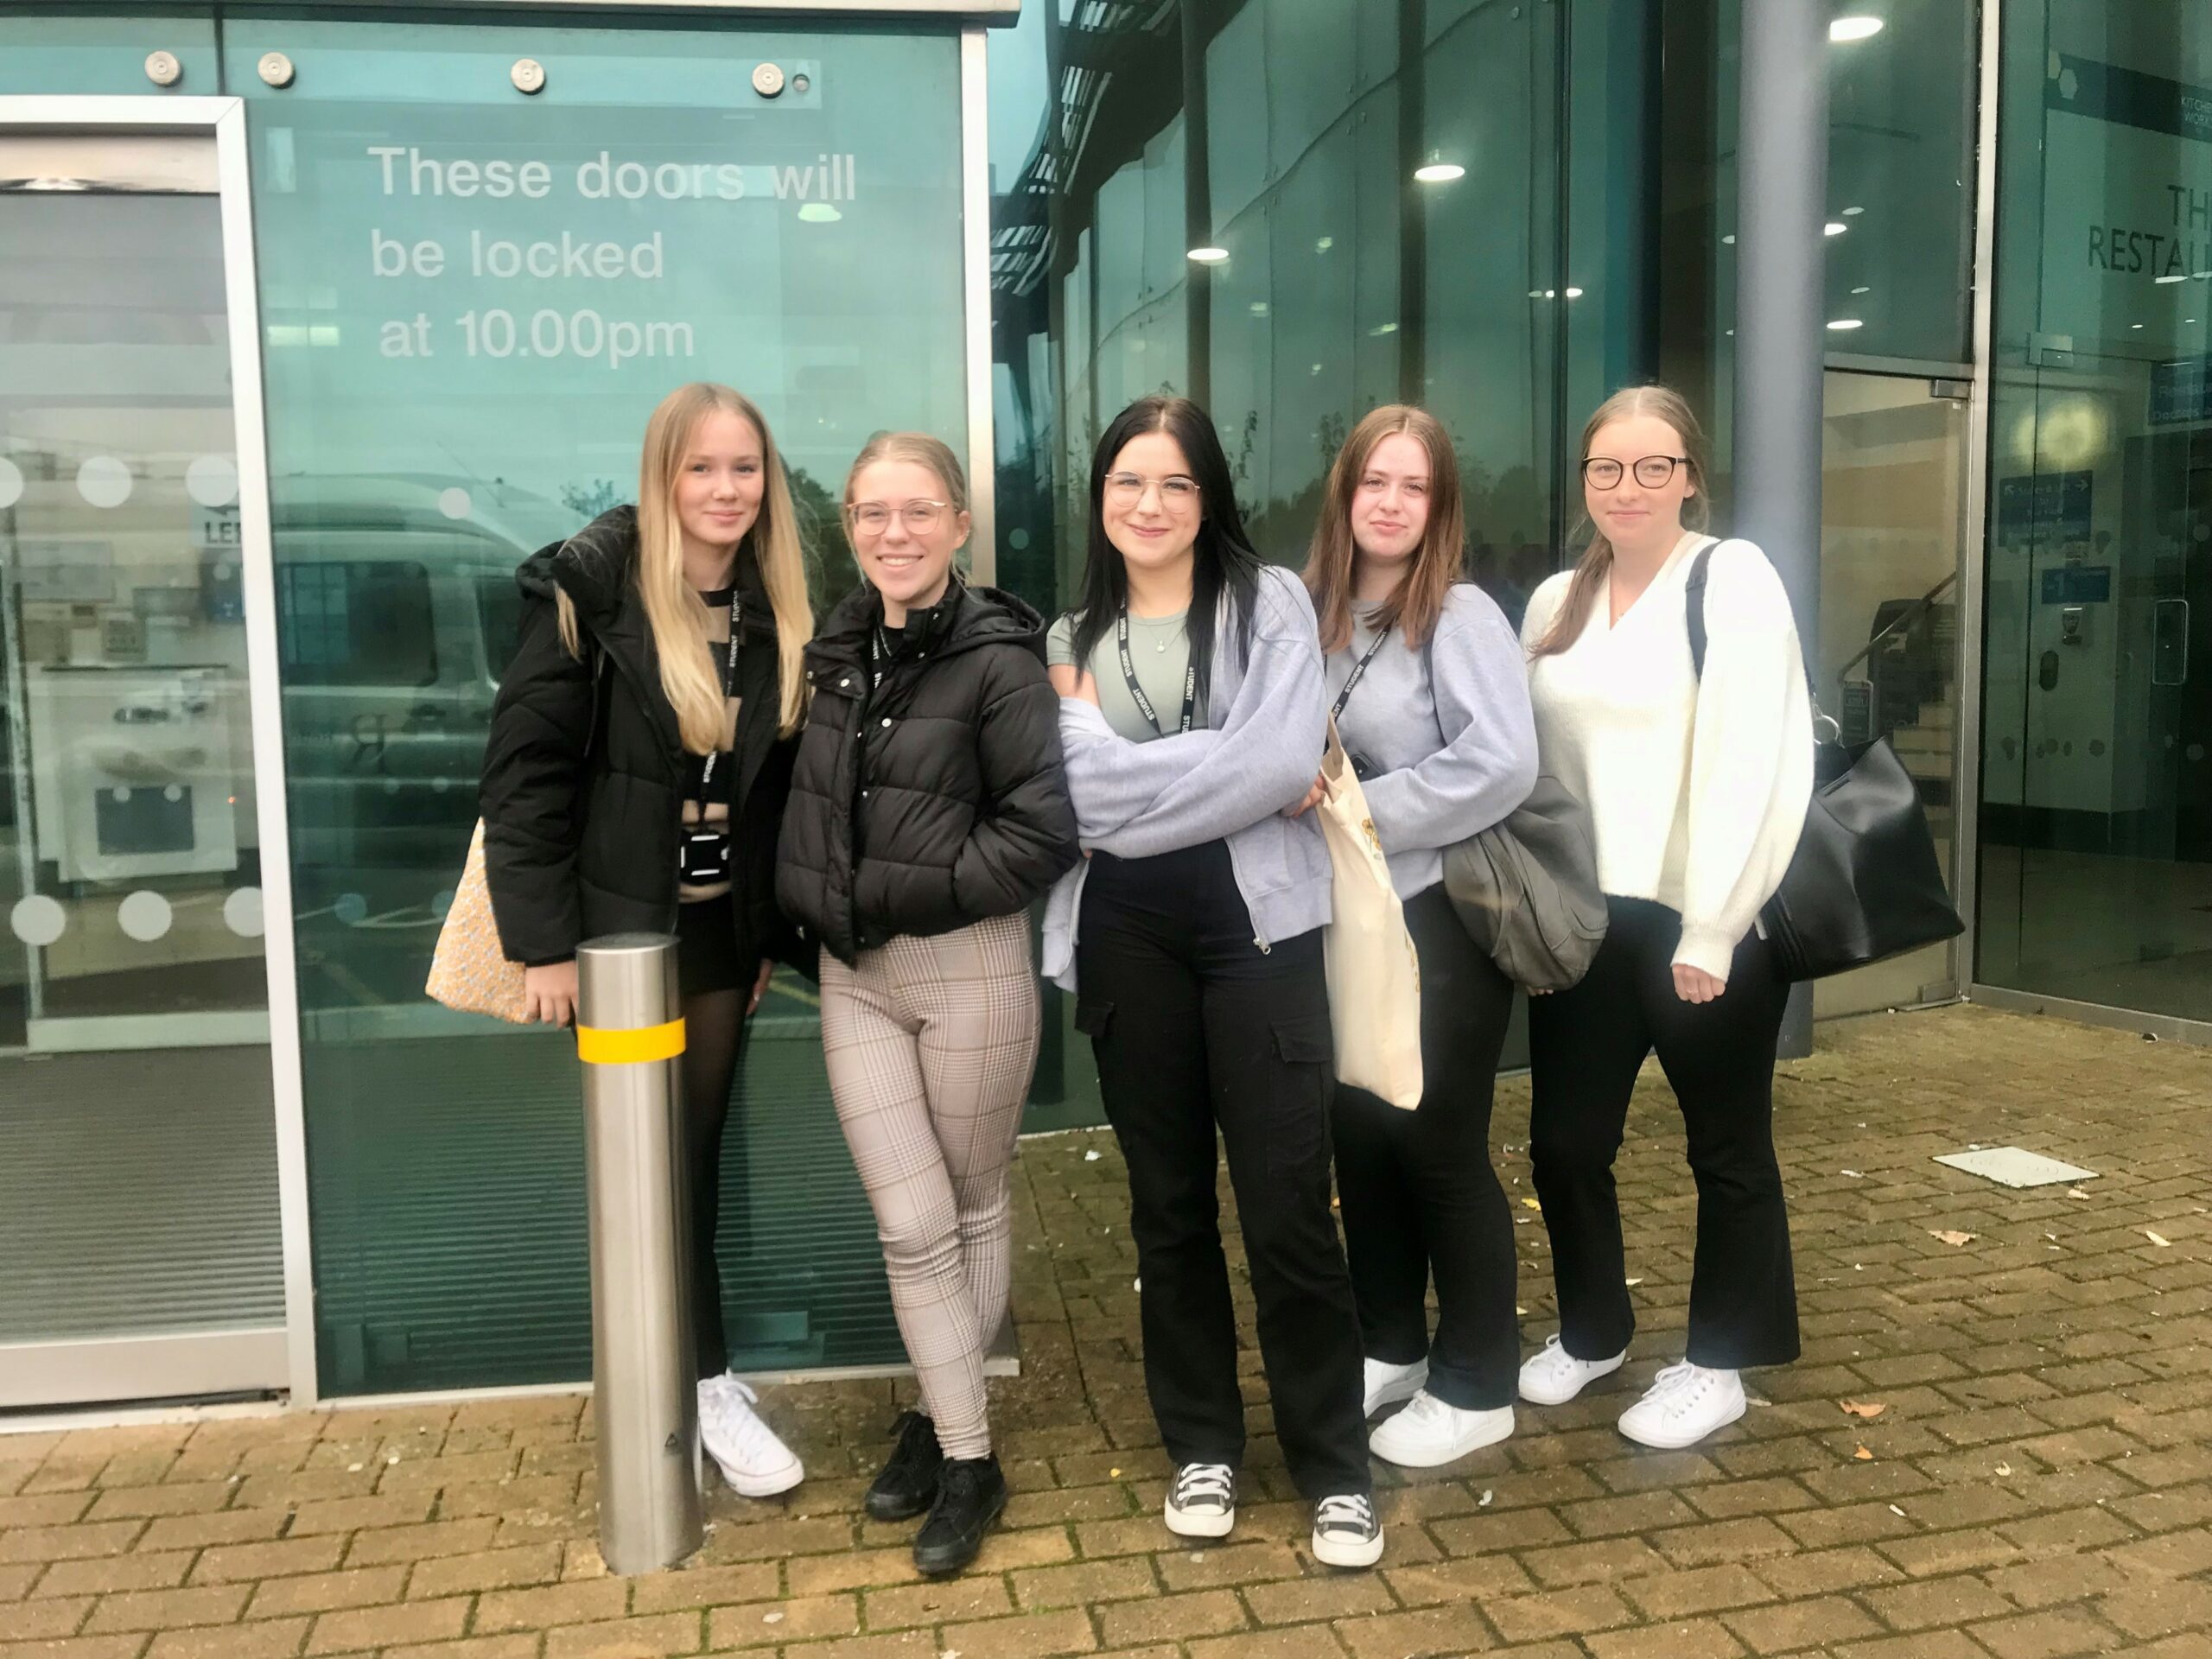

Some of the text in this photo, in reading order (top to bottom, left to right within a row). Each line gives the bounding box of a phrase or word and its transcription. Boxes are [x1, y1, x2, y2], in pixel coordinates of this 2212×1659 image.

[367, 147, 855, 200] These doors will
[371, 229, 664, 278] be locked
[379, 308, 695, 370] at 10.00pm
[205, 521, 242, 544] LE
[729, 635, 738, 668] STUDENT
[1121, 649, 1132, 677] STUDENT
[1185, 667, 1195, 701] STUDENT
[1344, 664, 1364, 694] STUDENT
[1132, 688, 1156, 721] STUDENT
